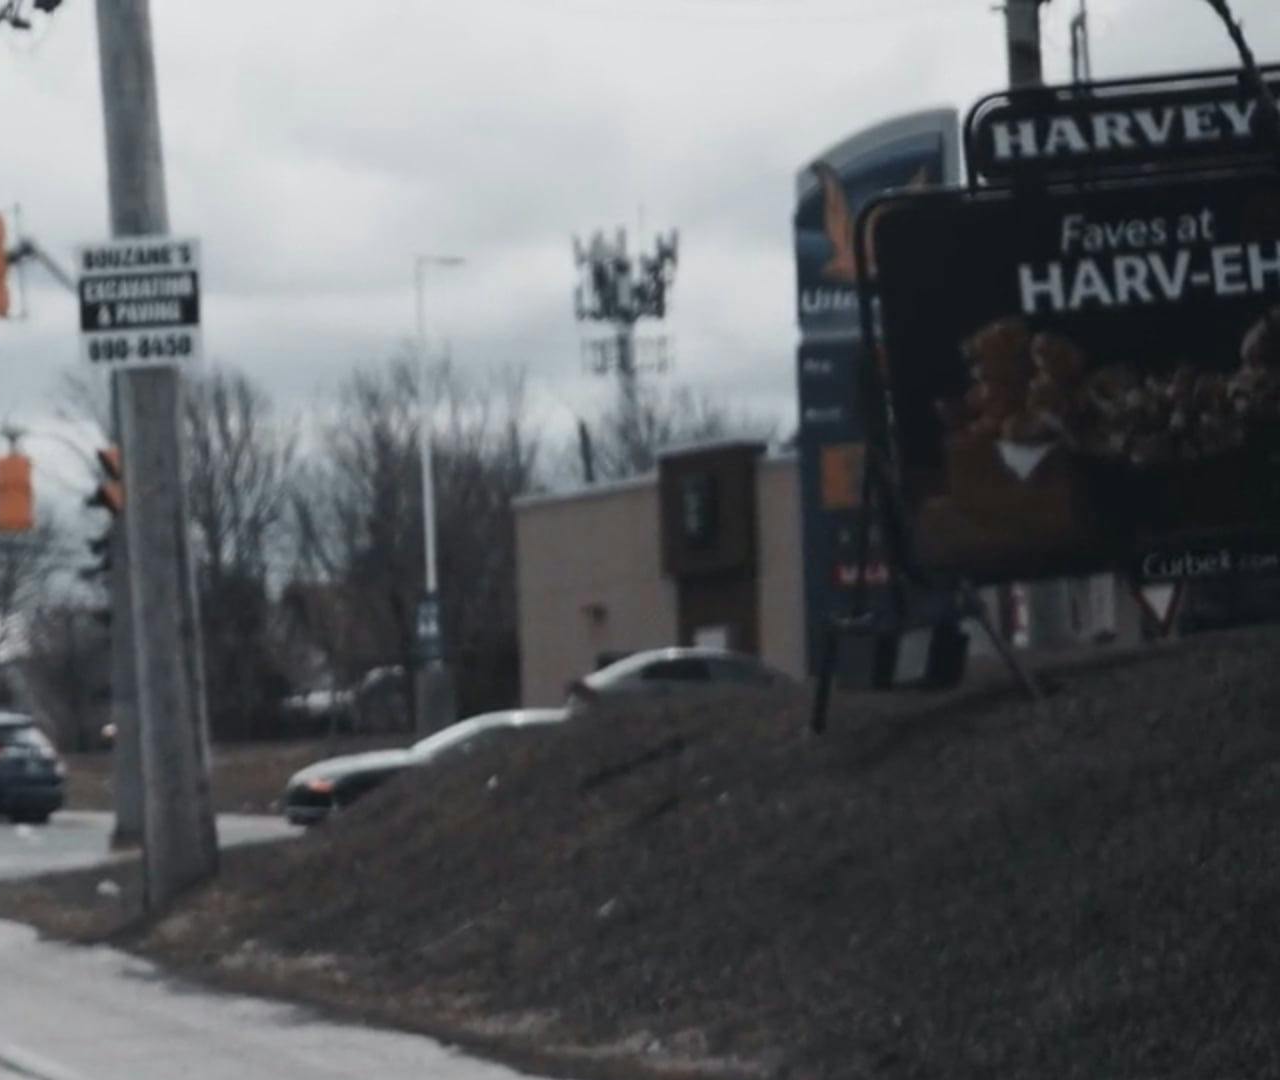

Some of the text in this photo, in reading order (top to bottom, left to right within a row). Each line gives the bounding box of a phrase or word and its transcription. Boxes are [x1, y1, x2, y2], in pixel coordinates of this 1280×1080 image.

[992, 100, 1280, 159] HARVEY
[1060, 207, 1215, 254] Faves at
[83, 243, 191, 270] BOUZANE'S
[115, 301, 181, 323] PAVING
